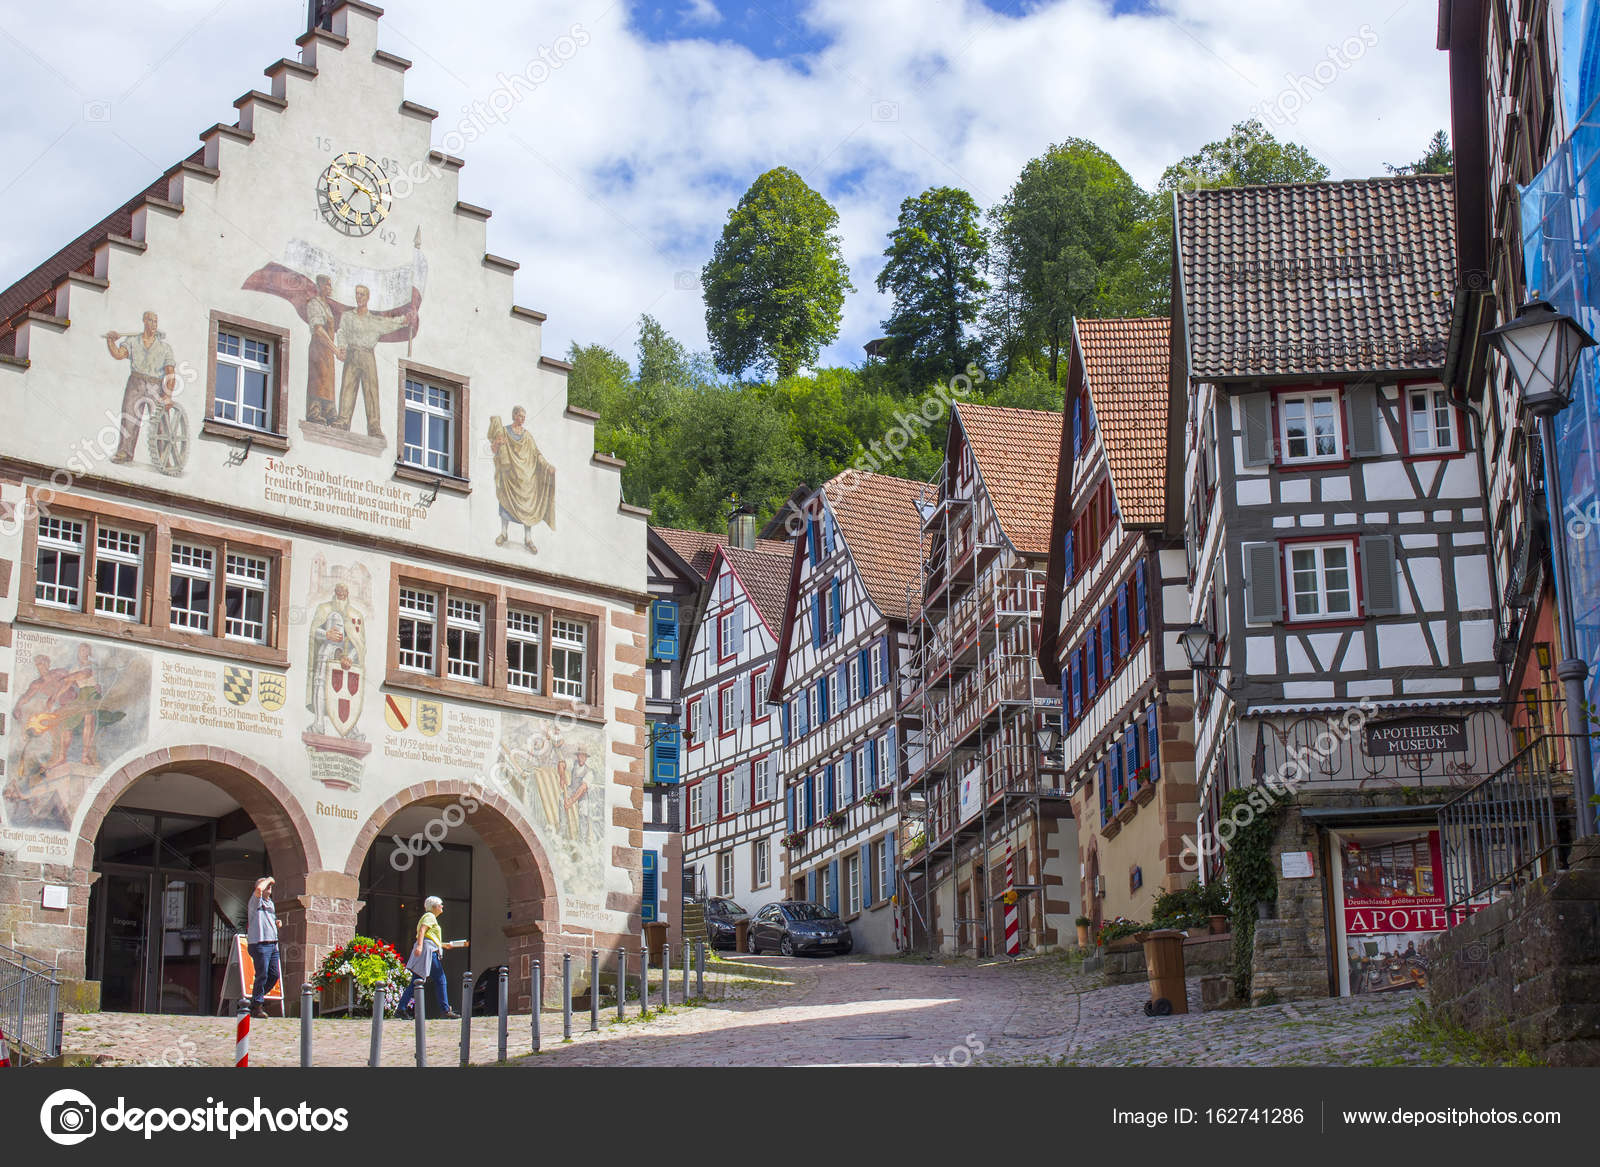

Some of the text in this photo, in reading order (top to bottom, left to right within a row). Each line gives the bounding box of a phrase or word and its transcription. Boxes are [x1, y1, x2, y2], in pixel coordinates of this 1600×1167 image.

[316, 137, 331, 152] 15
[1372, 724, 1460, 740] APOTHEKEN
[400, 736, 418, 749] 1952
[1388, 737, 1448, 752] MUSEUM
[316, 800, 359, 820] Rathaus
[1348, 897, 1390, 906] Deutschlands
[1416, 896, 1442, 905] privates
